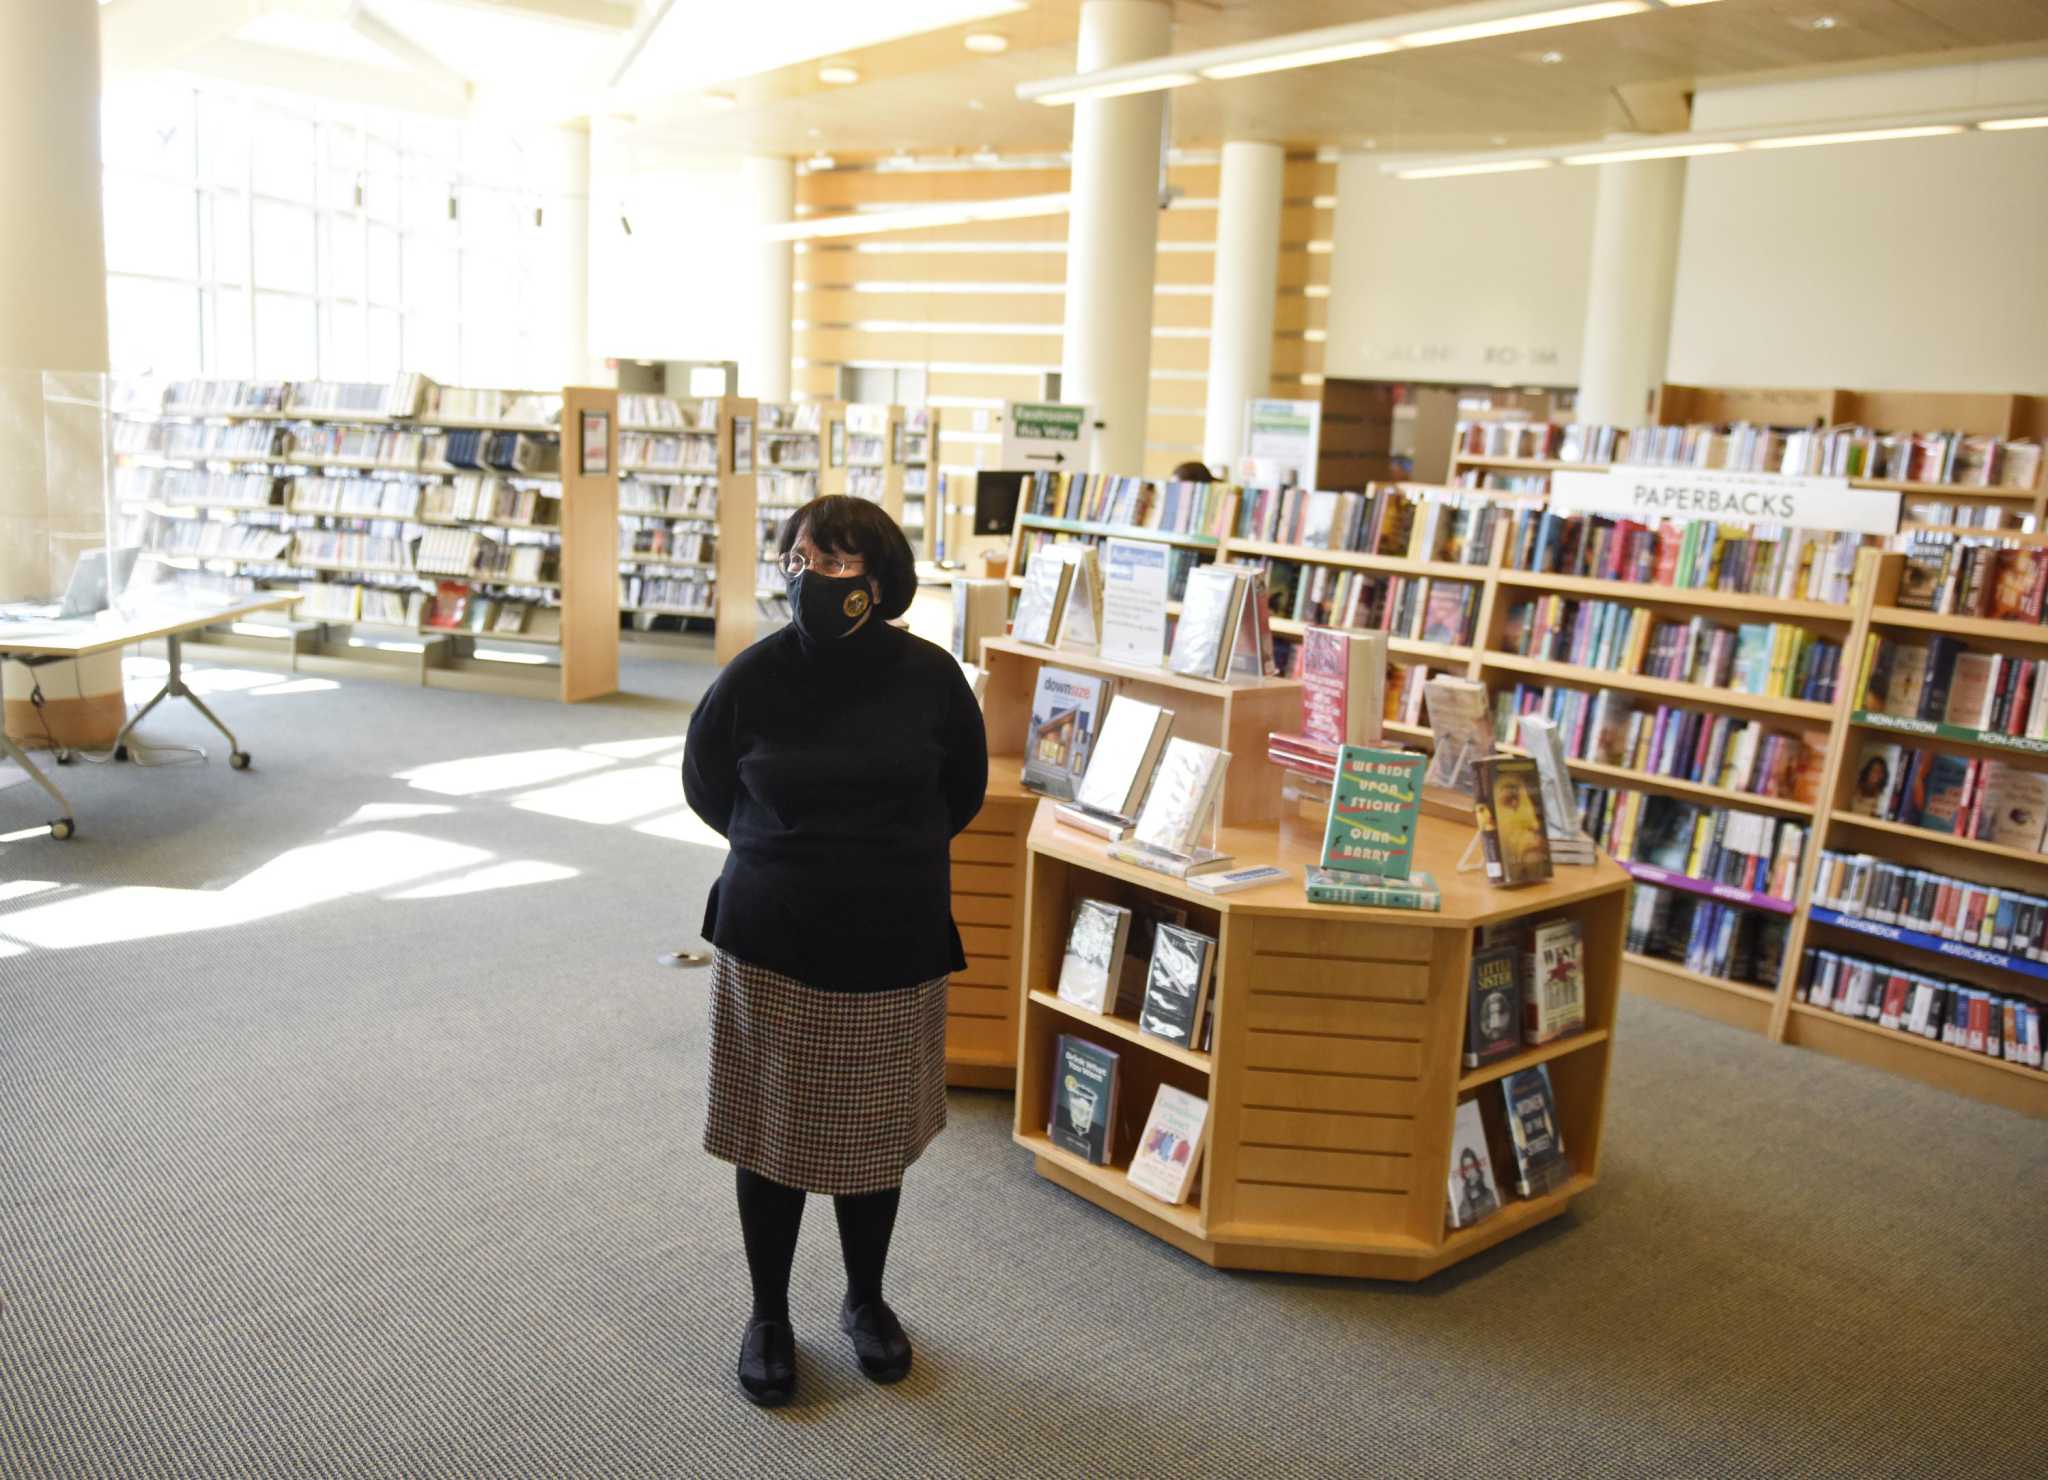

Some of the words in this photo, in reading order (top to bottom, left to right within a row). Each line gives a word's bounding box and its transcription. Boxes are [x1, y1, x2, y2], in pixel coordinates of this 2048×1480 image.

[1634, 485, 1795, 518] PAPERBACKS
[1866, 713, 1938, 734] NON-FICTION
[1352, 761, 1373, 774] WE
[1377, 763, 1412, 779] RIDE
[1350, 796, 1401, 814] STICKS
[1835, 915, 1901, 940] AUDIOBOOK
[1940, 942, 2011, 968] AUDIOBOOK
